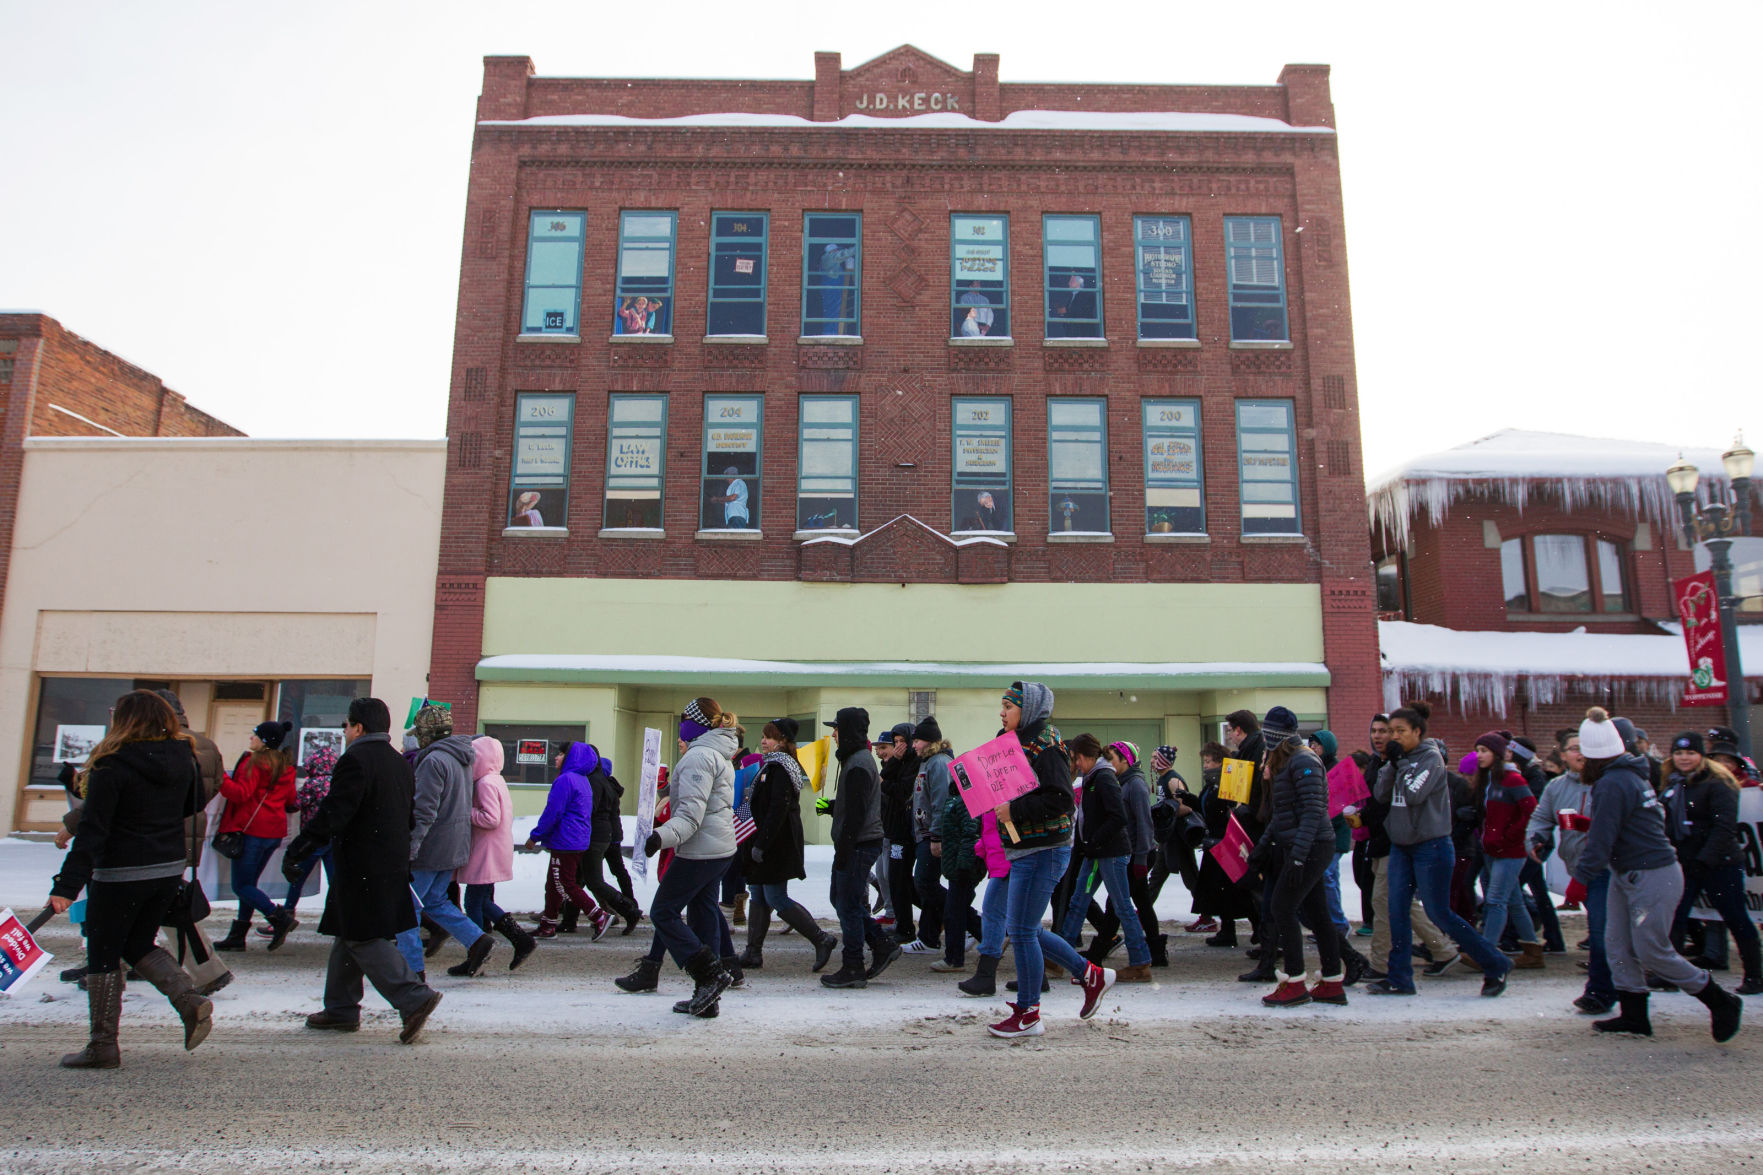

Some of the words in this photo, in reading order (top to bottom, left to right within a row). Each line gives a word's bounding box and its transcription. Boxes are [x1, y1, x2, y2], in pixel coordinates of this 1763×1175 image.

[898, 92, 959, 110] KECK
[1151, 225, 1173, 236] 300
[1150, 260, 1176, 268] STUDIO
[546, 316, 563, 327] ICE
[530, 406, 557, 418] 206
[971, 409, 990, 421] 202
[1159, 409, 1183, 422] 200
[619, 442, 650, 455] LAW
[614, 455, 651, 469] OFFICE
[10, 927, 25, 941] fall
[1, 933, 26, 960] Divided
[23, 939, 31, 951] we
